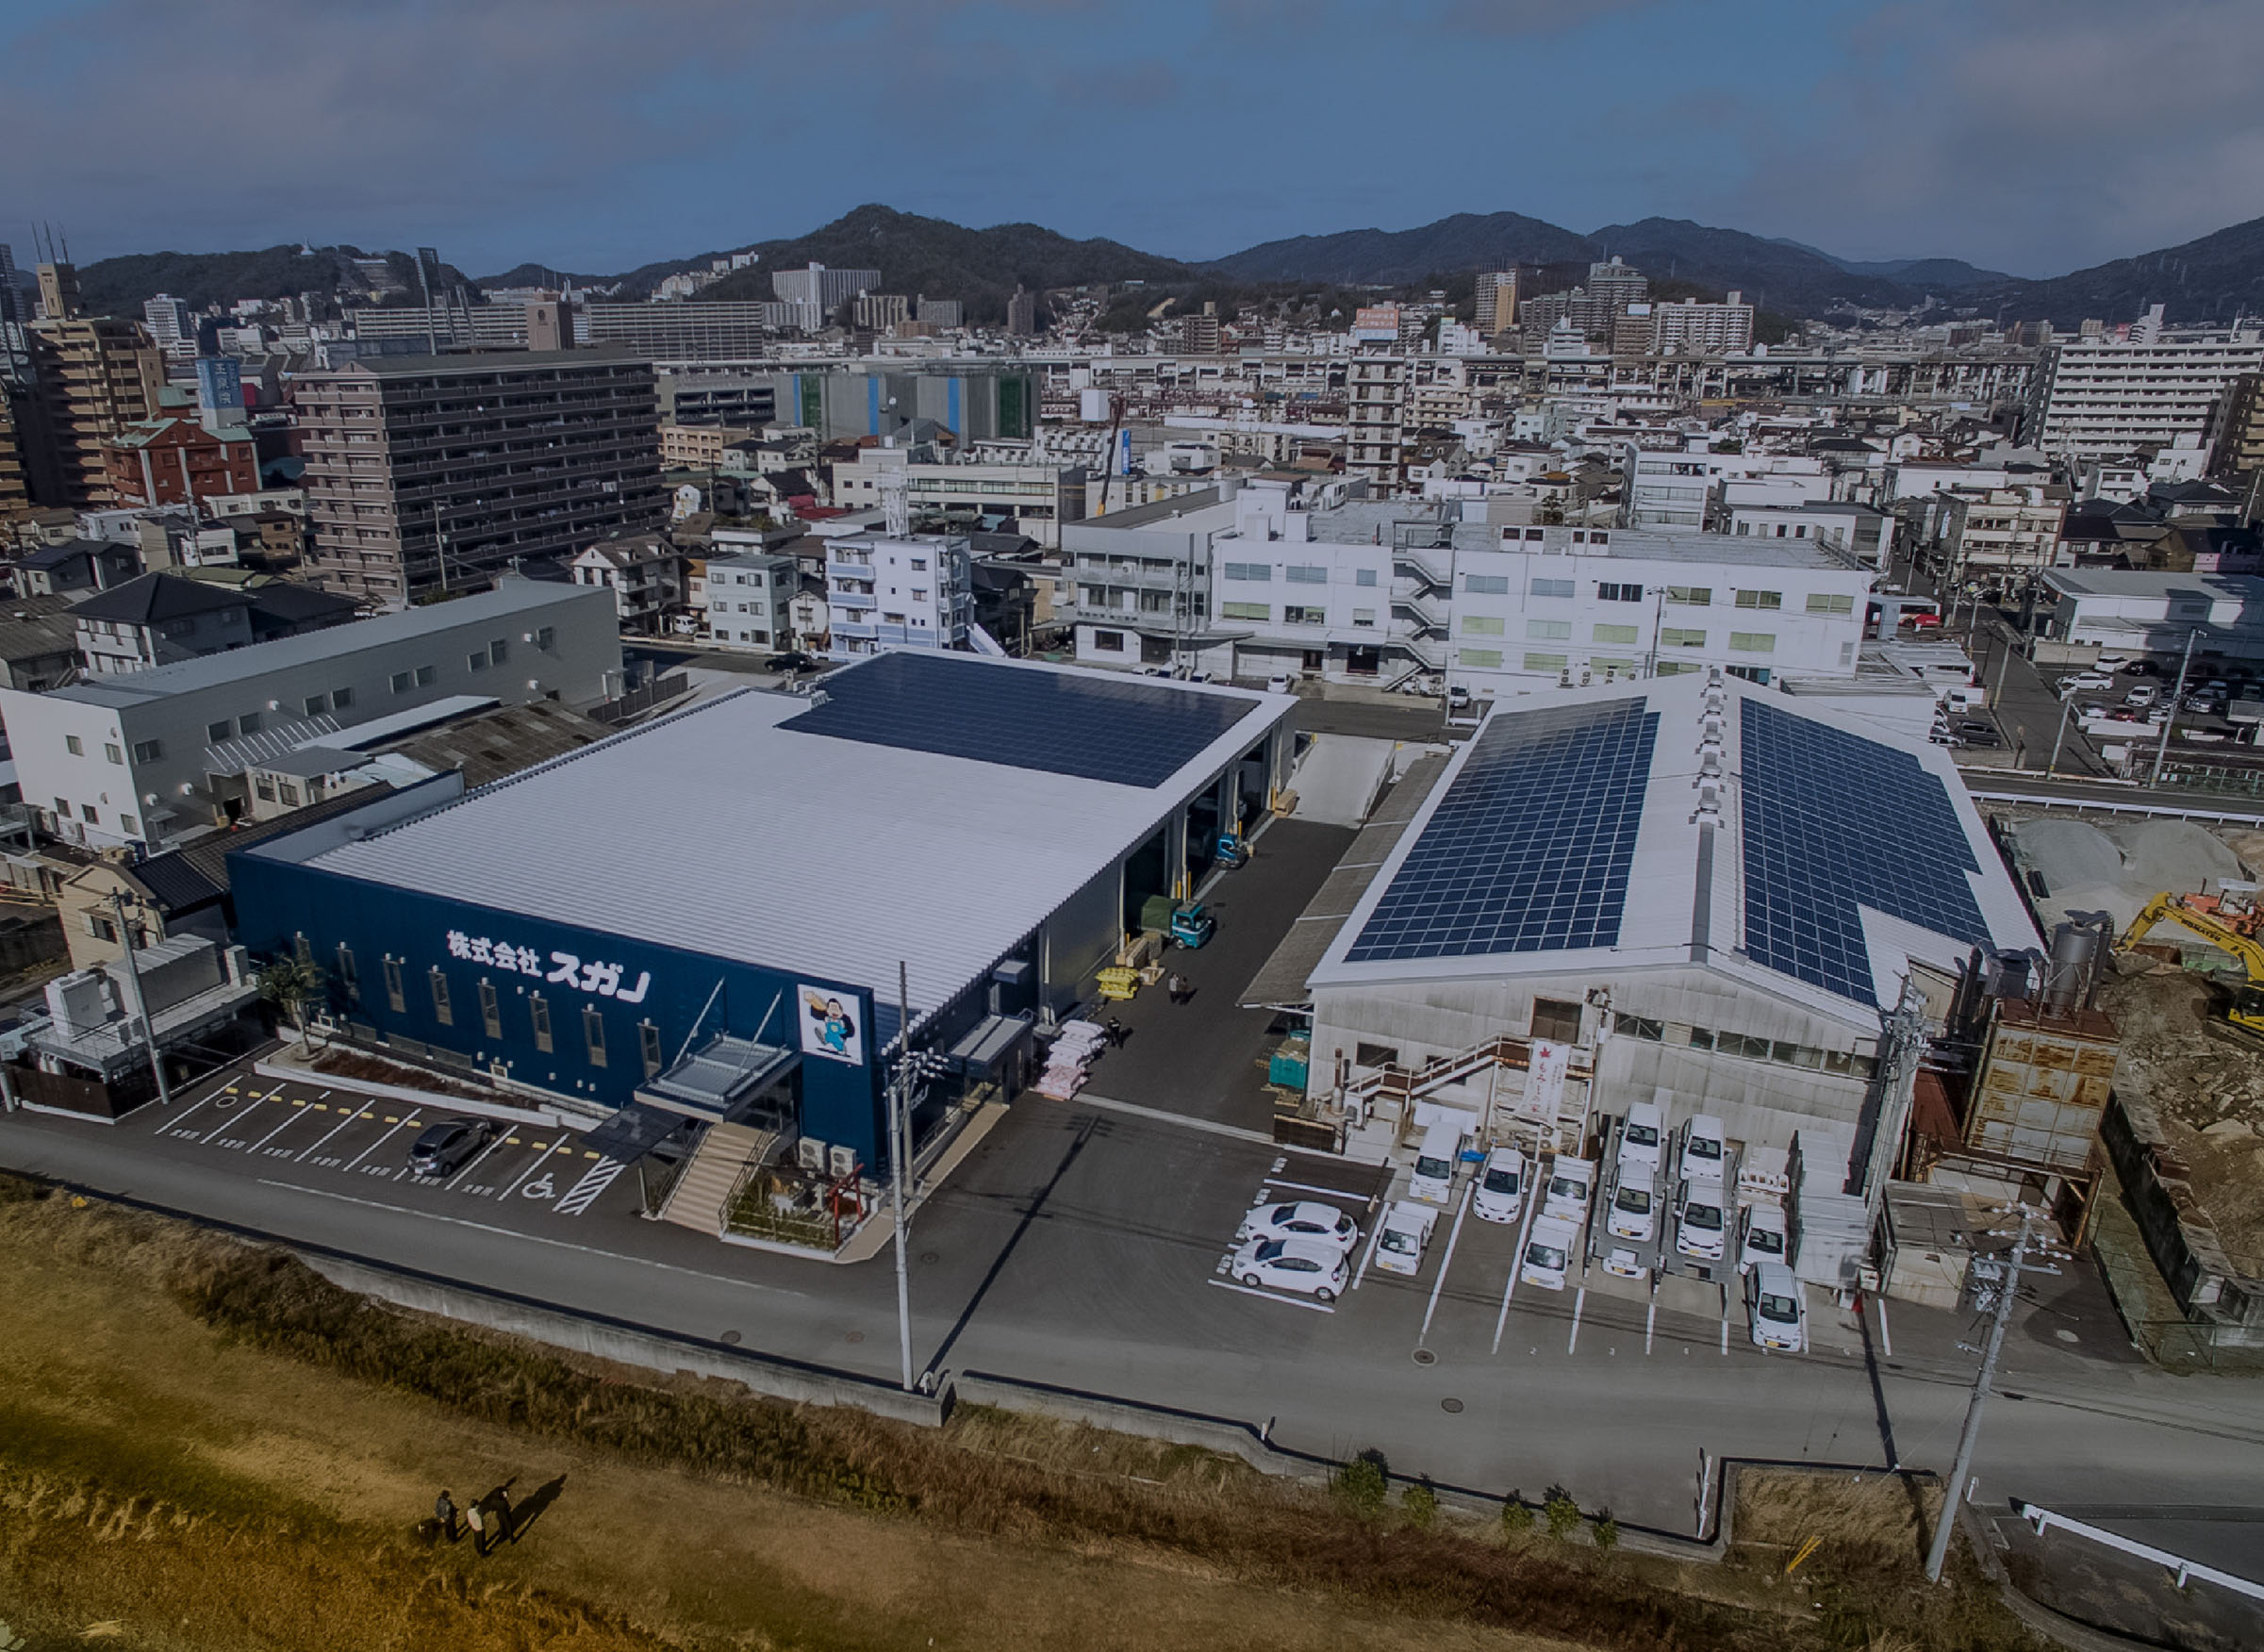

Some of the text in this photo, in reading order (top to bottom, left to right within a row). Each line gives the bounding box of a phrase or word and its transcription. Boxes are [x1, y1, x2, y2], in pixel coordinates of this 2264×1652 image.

[2181, 918, 2222, 941] KOMATSU
[447, 930, 651, 1003] 株式会社 スガノ
